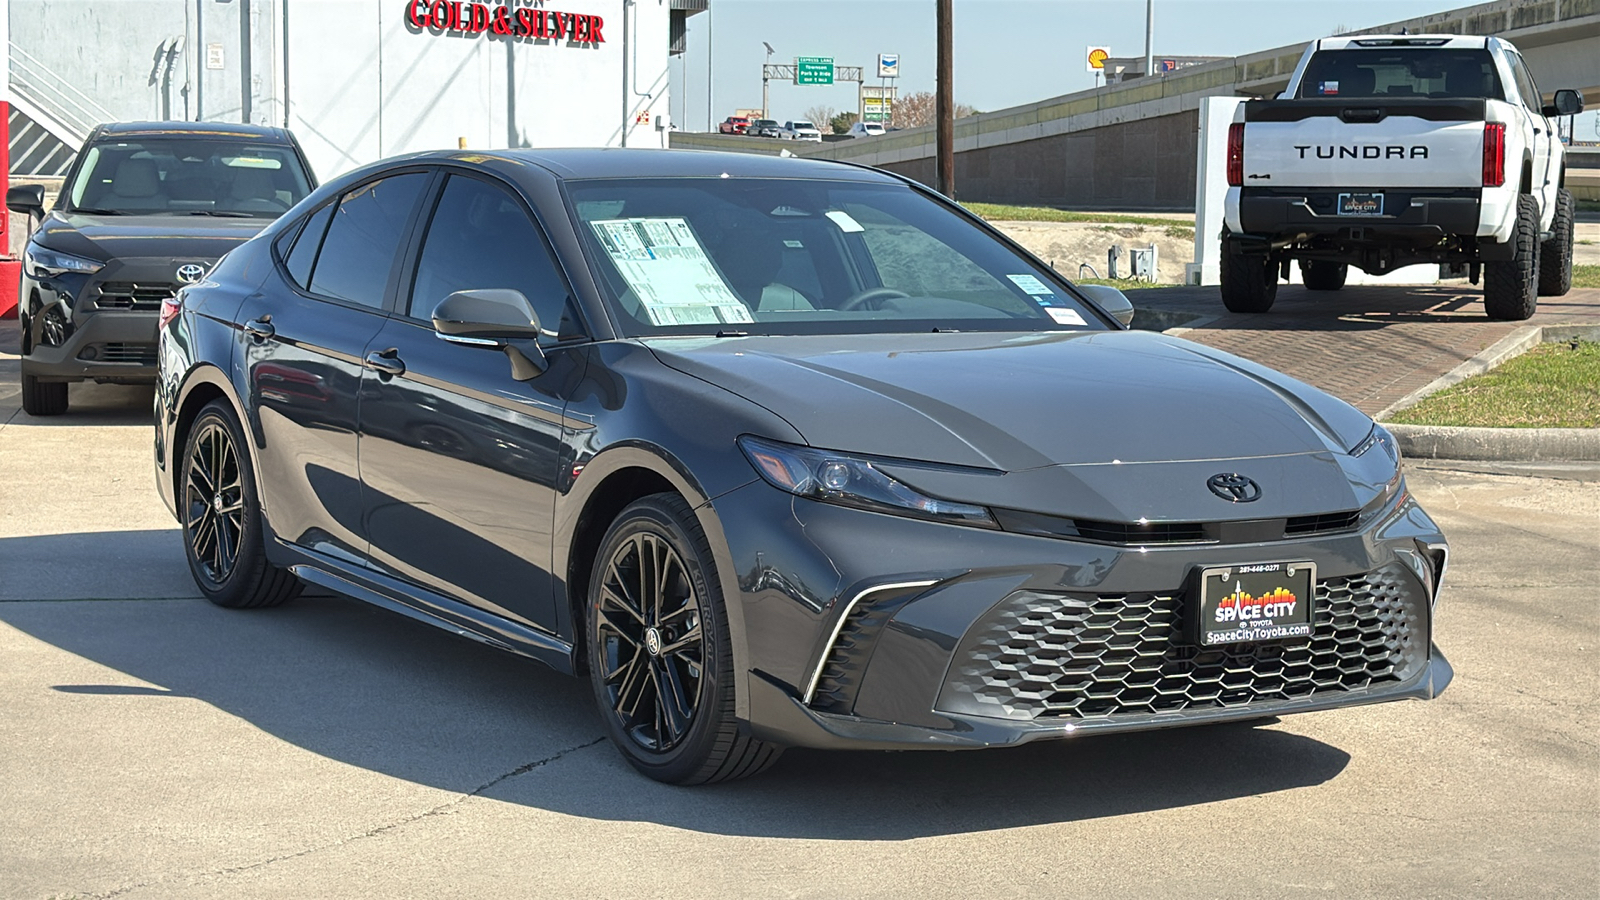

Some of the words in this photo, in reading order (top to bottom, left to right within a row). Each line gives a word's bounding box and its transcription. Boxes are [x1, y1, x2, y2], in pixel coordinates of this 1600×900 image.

[409, 0, 490, 33] GOLD
[516, 8, 606, 43] SILVER
[1293, 145, 1429, 160] TUNDRA
[1215, 604, 1261, 622] SPACE
[1263, 602, 1297, 617] CITY
[1249, 620, 1273, 628] TOYOTA
[1207, 625, 1309, 643] SpaceCityToyota.com
